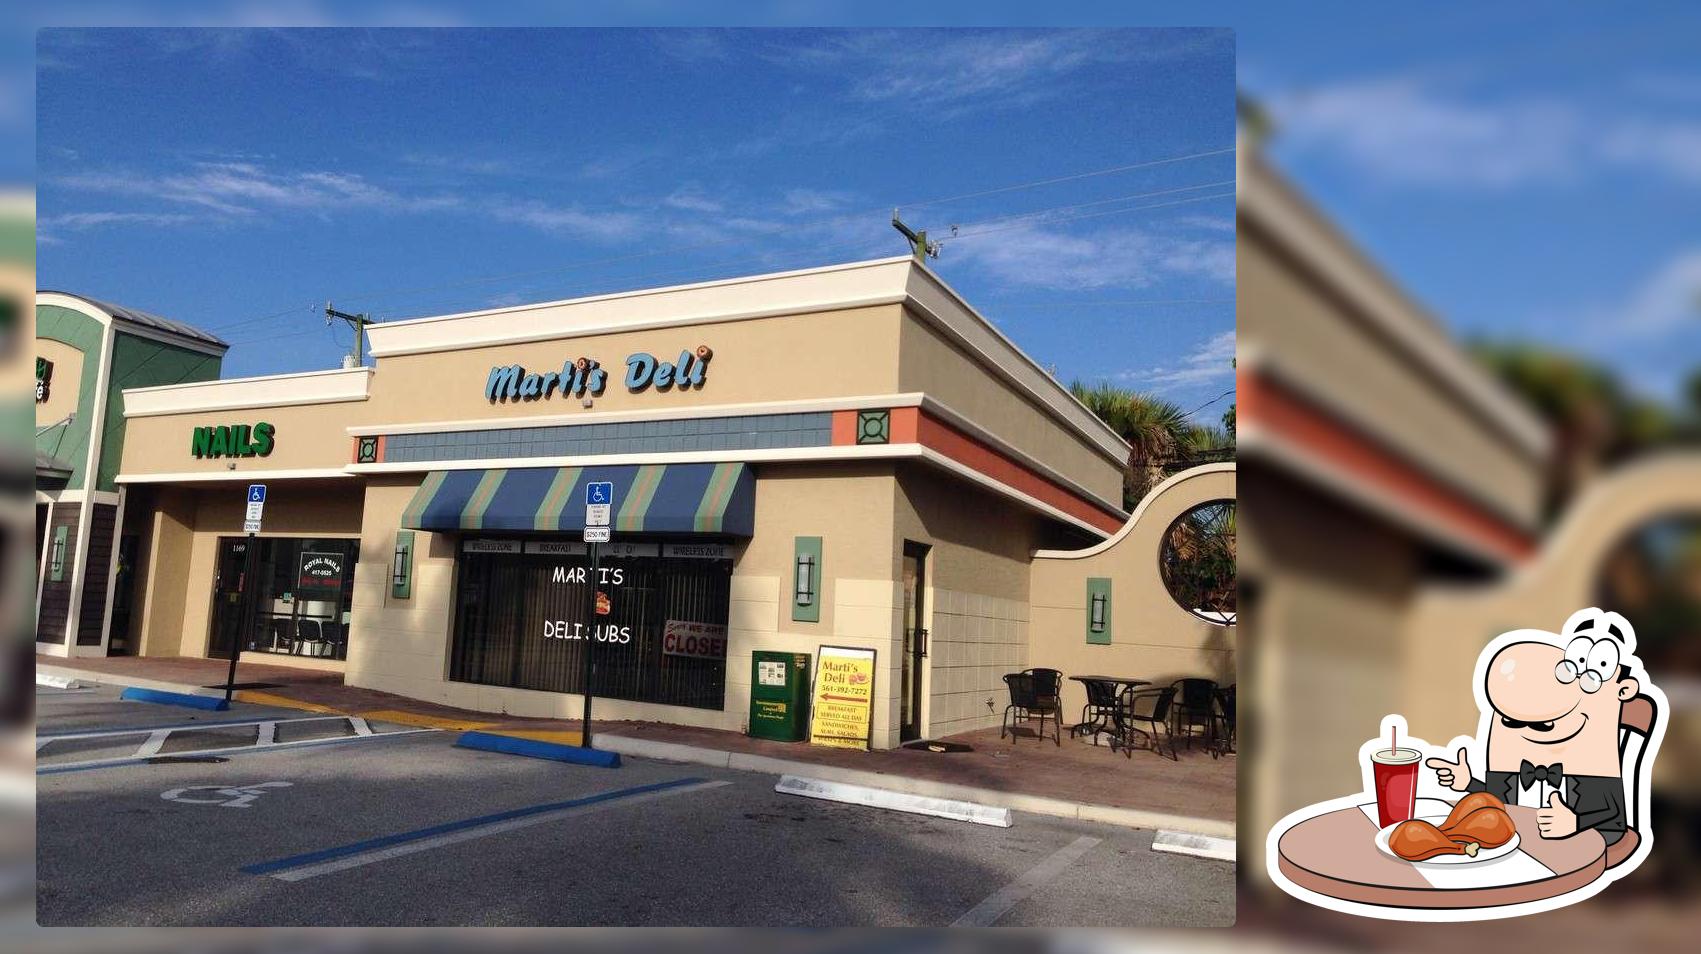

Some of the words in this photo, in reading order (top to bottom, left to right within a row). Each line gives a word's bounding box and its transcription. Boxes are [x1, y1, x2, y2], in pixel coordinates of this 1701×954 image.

[485, 357, 607, 402] Marti's
[625, 345, 712, 393] Deli
[191, 422, 275, 459] NAILS
[303, 557, 323, 571] ROYAL
[323, 557, 341, 573] NAILS
[552, 566, 624, 585] MARI'S
[543, 620, 583, 639] DELI
[664, 633, 726, 657] CLOSE
[822, 661, 859, 673] Marti's
[824, 672, 845, 683] Deli
[822, 685, 867, 695] 561-392-7272
